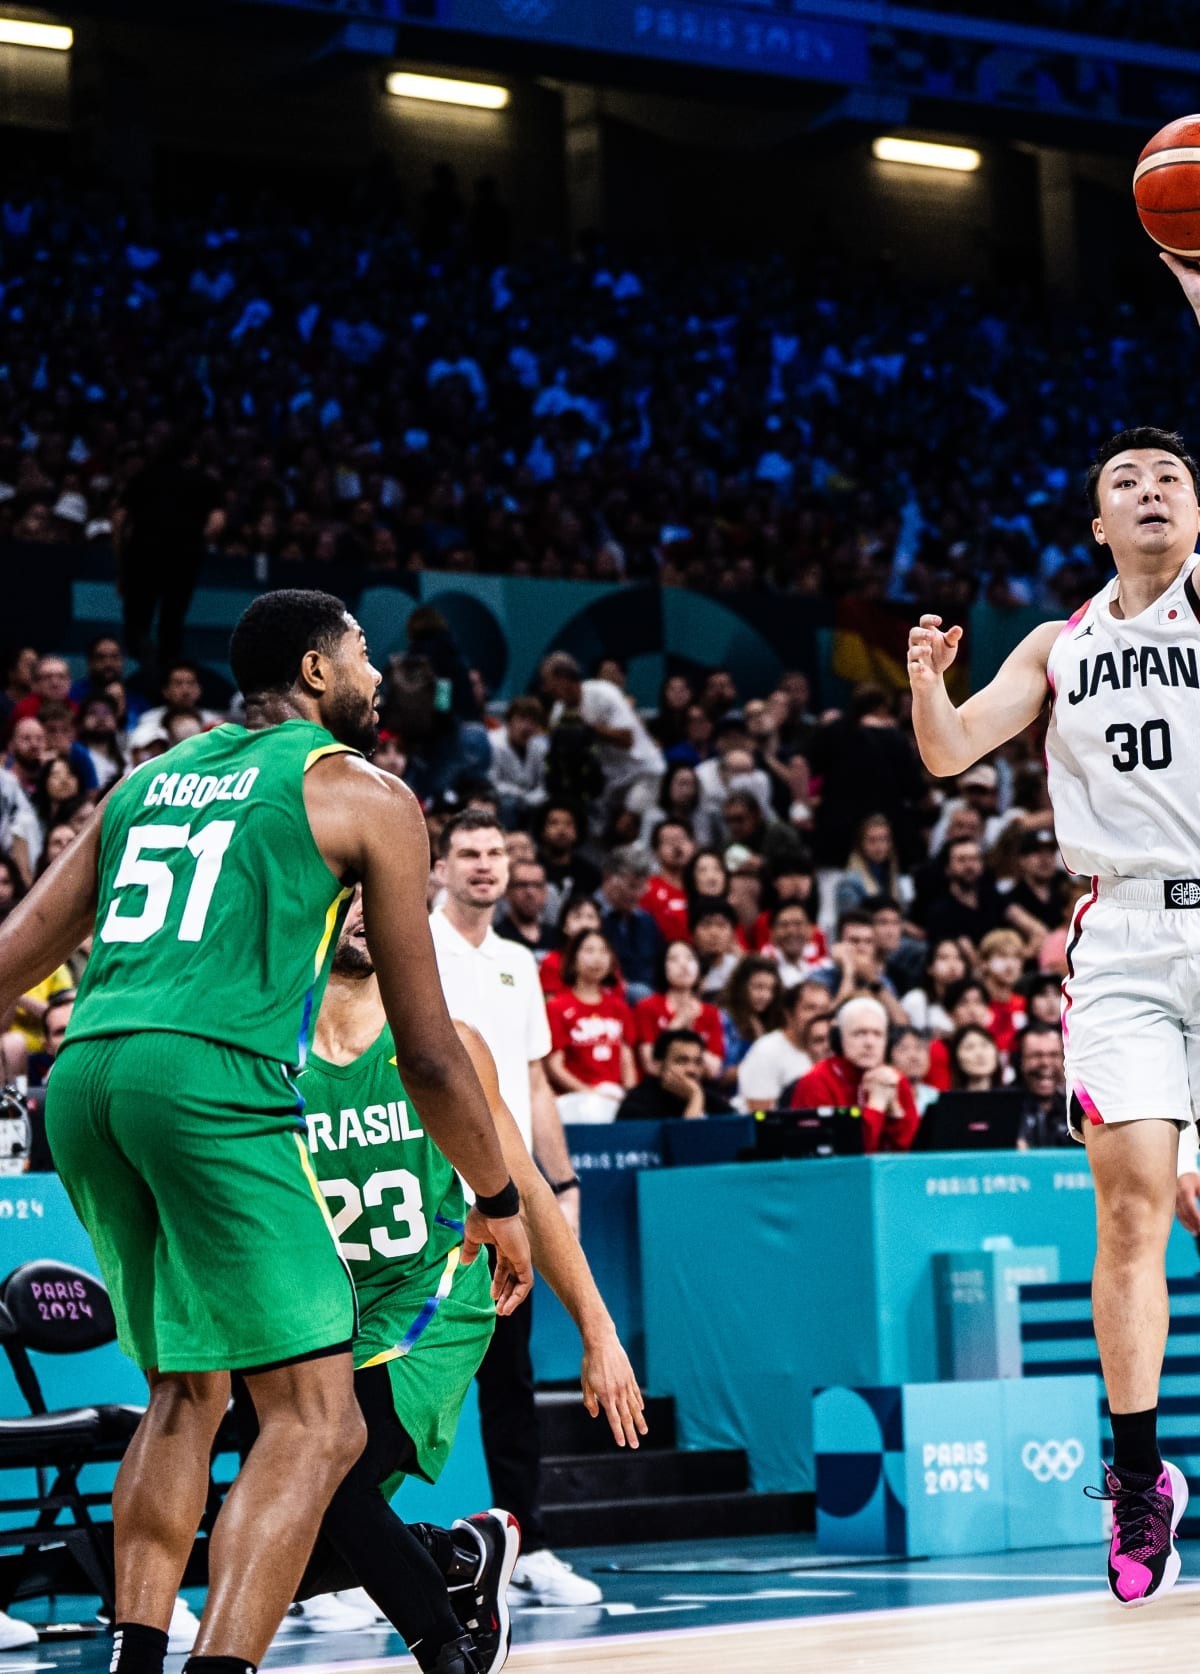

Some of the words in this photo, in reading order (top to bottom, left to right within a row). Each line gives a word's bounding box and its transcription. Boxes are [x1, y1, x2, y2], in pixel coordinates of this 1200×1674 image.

[1068, 646, 1200, 706] JAPAN
[1105, 718, 1172, 772] 30
[100, 820, 236, 943] 51
[305, 1100, 424, 1153] RASIL
[0, 1199, 44, 1219] 024
[317, 1168, 428, 1261] 23
[31, 1280, 86, 1300] PARIS
[38, 1301, 93, 1320] 2024
[922, 1441, 988, 1468] PARIS
[924, 1468, 989, 1495] 2024
